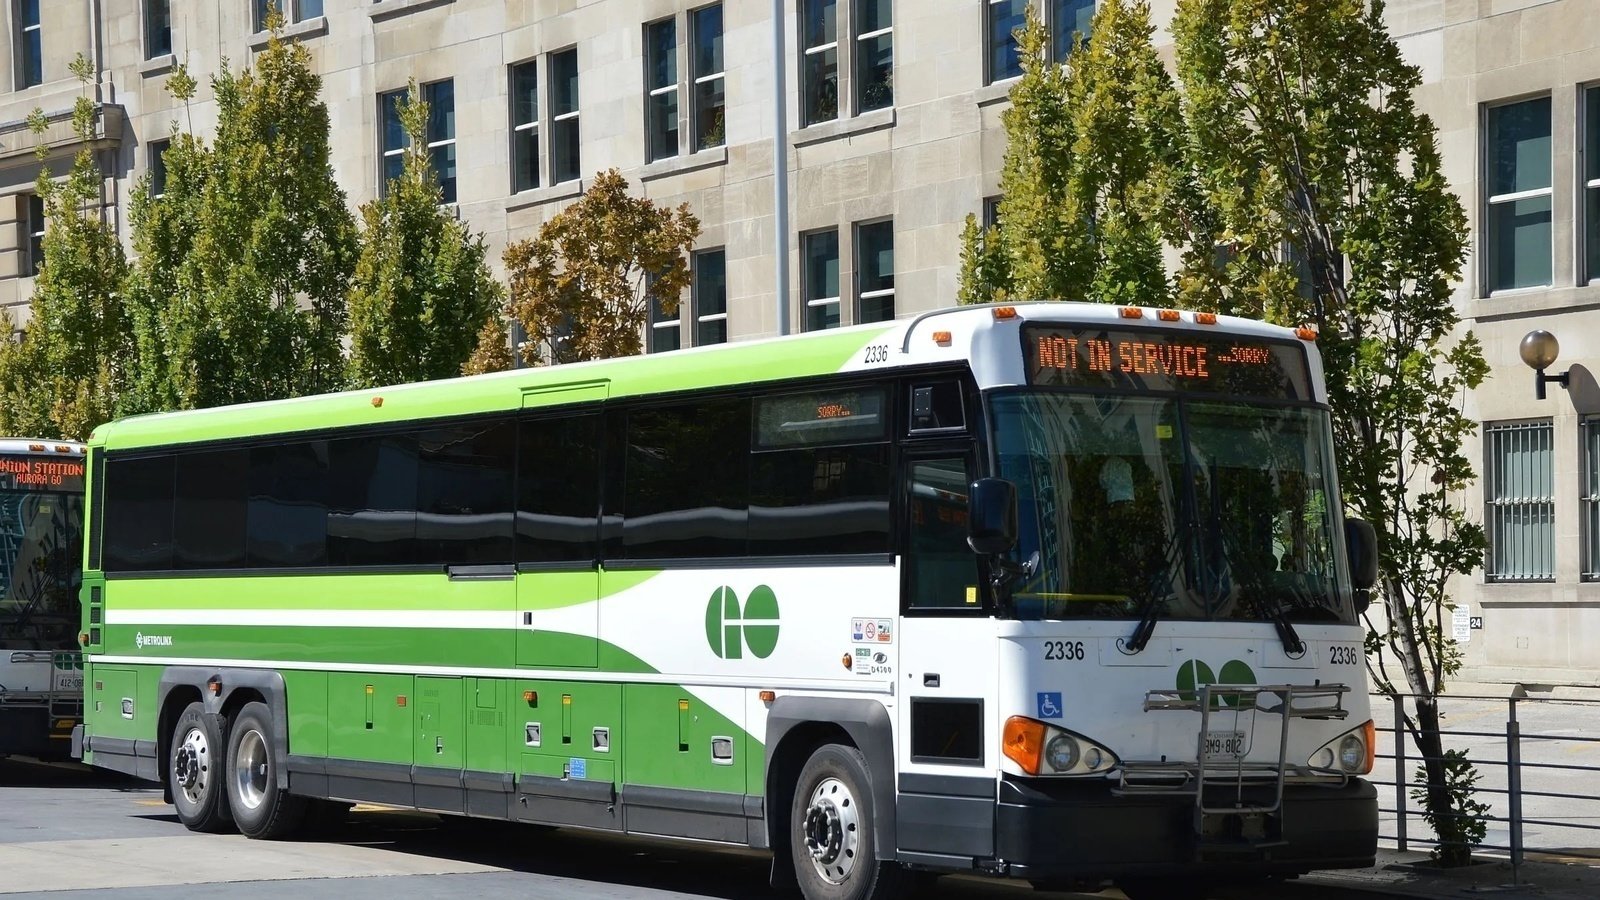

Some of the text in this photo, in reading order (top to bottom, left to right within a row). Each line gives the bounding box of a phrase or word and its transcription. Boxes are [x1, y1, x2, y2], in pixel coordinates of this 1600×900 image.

[864, 344, 889, 364] 2336
[1038, 336, 1078, 369] NOT
[1087, 339, 1111, 371] IN
[1119, 341, 1209, 377] SERVICE
[34, 462, 84, 476] STATION
[16, 474, 62, 485] AURORA GO
[1470, 618, 1481, 628] 24
[142, 635, 173, 646] METROLINX
[1044, 641, 1085, 661] 2336
[1329, 646, 1358, 665] 2336
